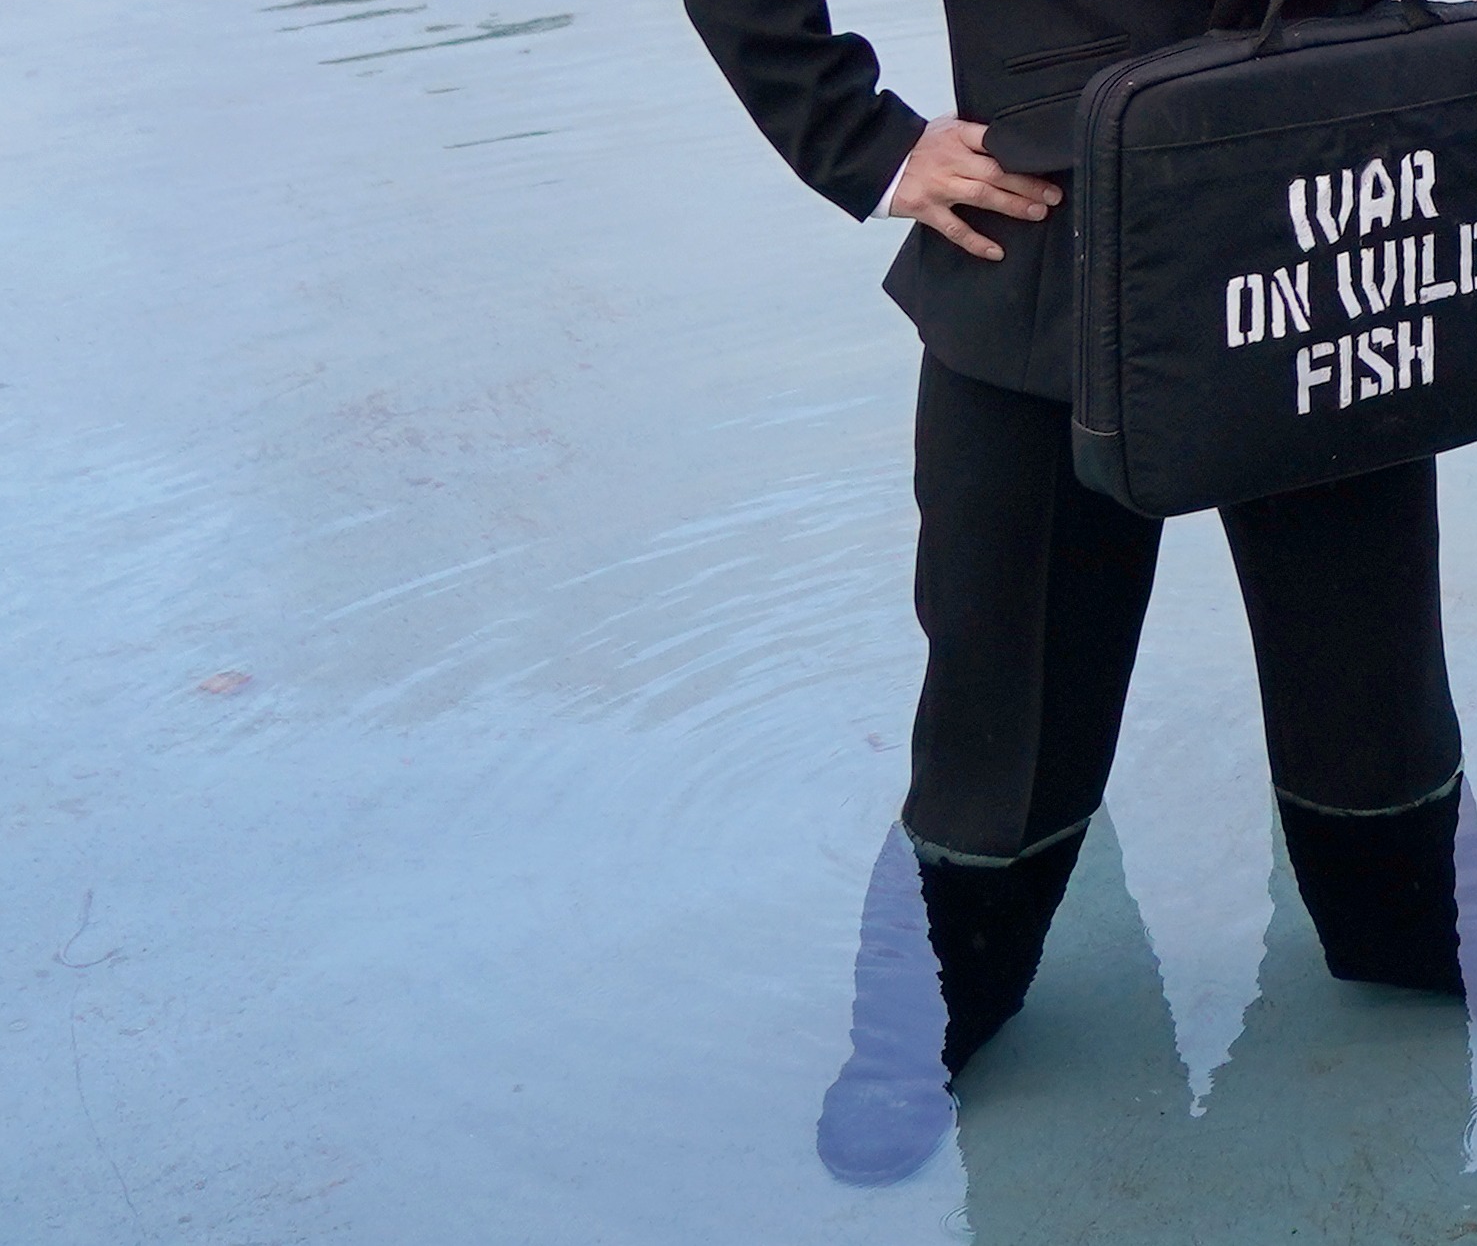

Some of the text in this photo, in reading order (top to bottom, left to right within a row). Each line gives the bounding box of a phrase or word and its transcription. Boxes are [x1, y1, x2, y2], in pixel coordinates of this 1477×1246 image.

[1288, 149, 1439, 252] WAR
[1226, 261, 1311, 348] ON
[1296, 315, 1435, 415] FISH
